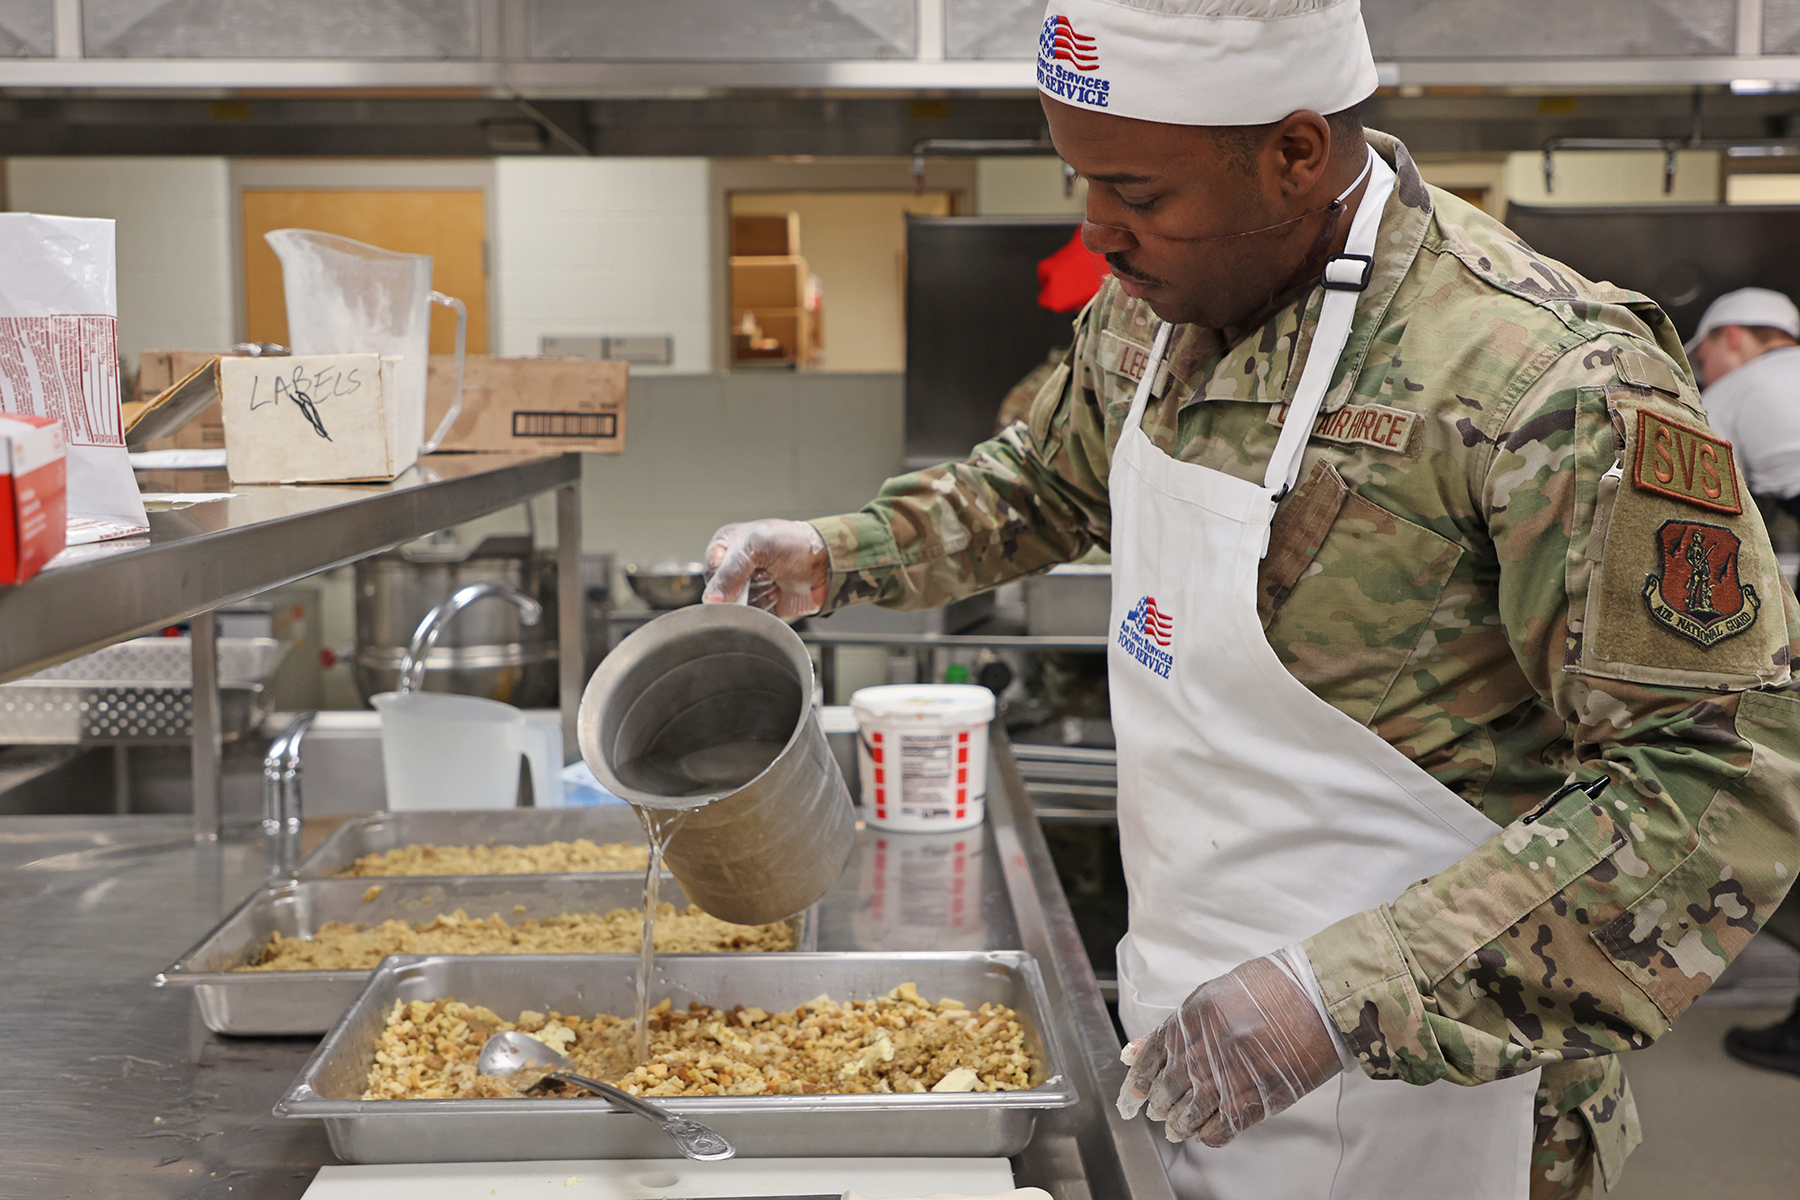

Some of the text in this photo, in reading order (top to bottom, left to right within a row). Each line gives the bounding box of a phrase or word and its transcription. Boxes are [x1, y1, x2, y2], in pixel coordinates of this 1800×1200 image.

[1045, 74, 1109, 107] SERVICE
[1055, 64, 1110, 91] SERVICES
[250, 364, 361, 411] LABELS
[1315, 409, 1353, 439] AIR
[1652, 425, 1722, 499] SVS
[1654, 605, 1752, 643] AIR NATIONAL GUARD
[1117, 630, 1172, 680] FOOD SERVICE
[1144, 638, 1173, 665] SERVICES
